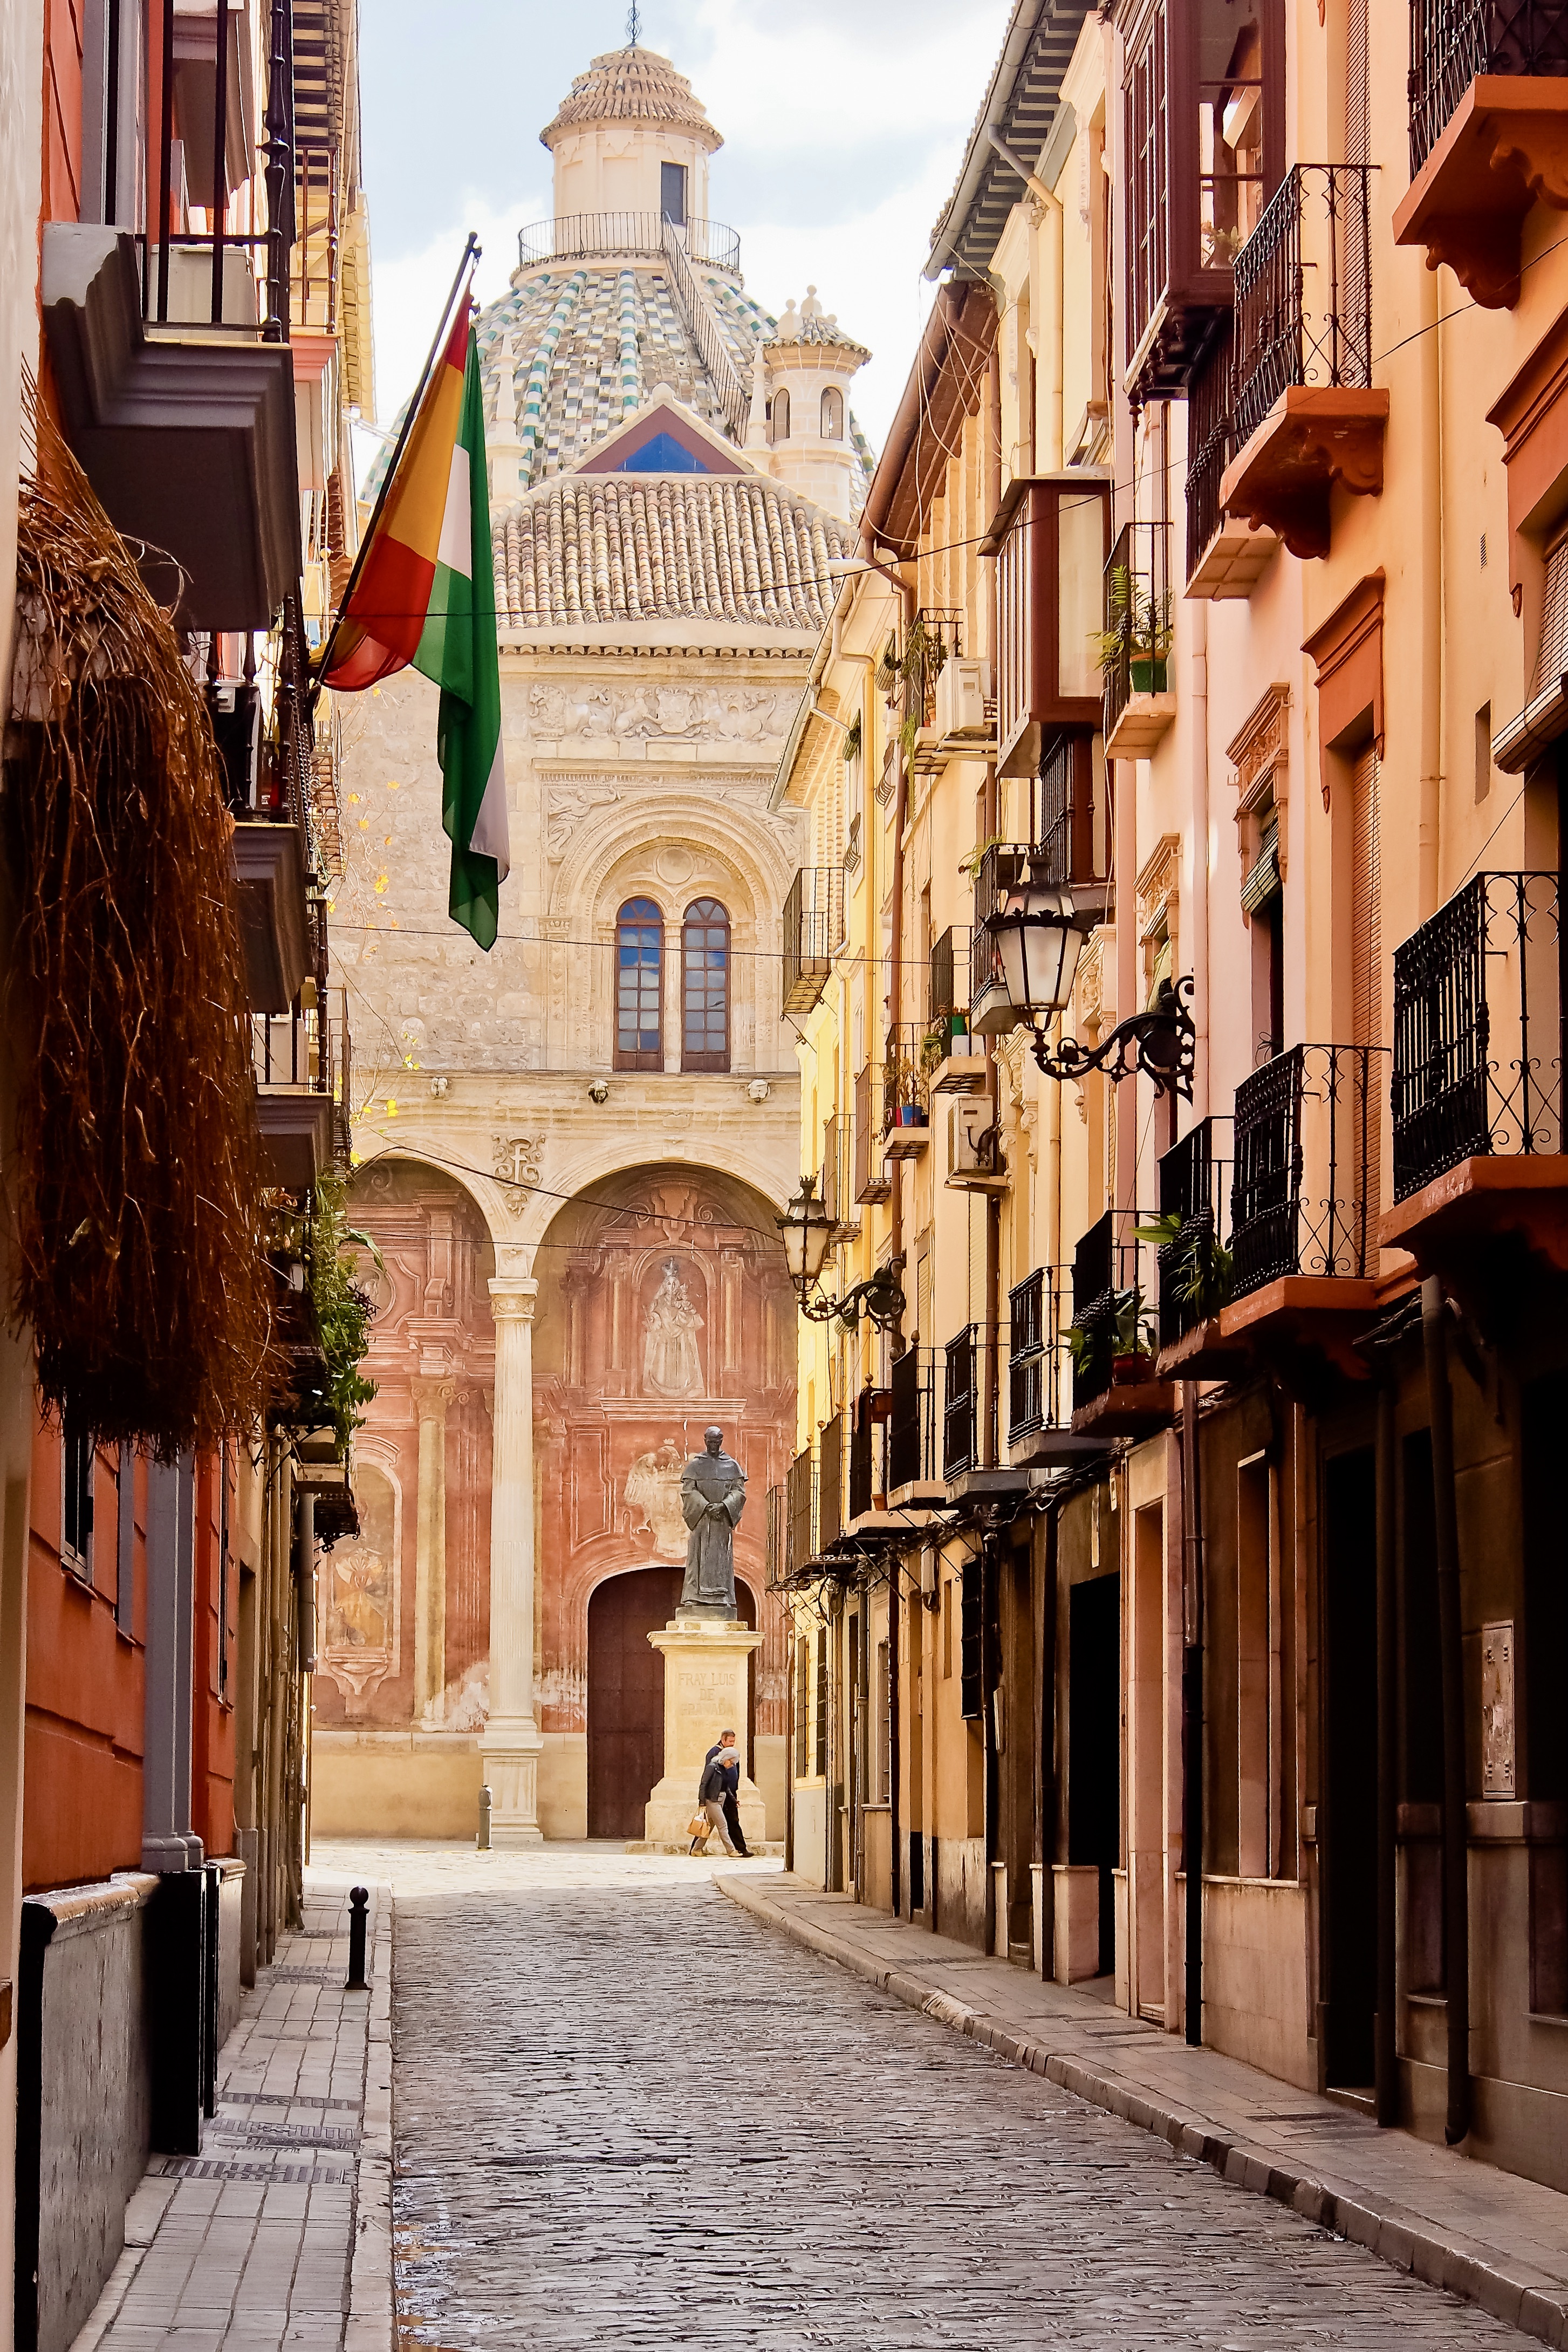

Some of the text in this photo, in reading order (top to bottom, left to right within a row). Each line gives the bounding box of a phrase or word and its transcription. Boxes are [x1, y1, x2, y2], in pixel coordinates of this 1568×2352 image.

[678, 1672, 735, 1686] FRAY LUIS
[700, 1688, 715, 1701] DE
